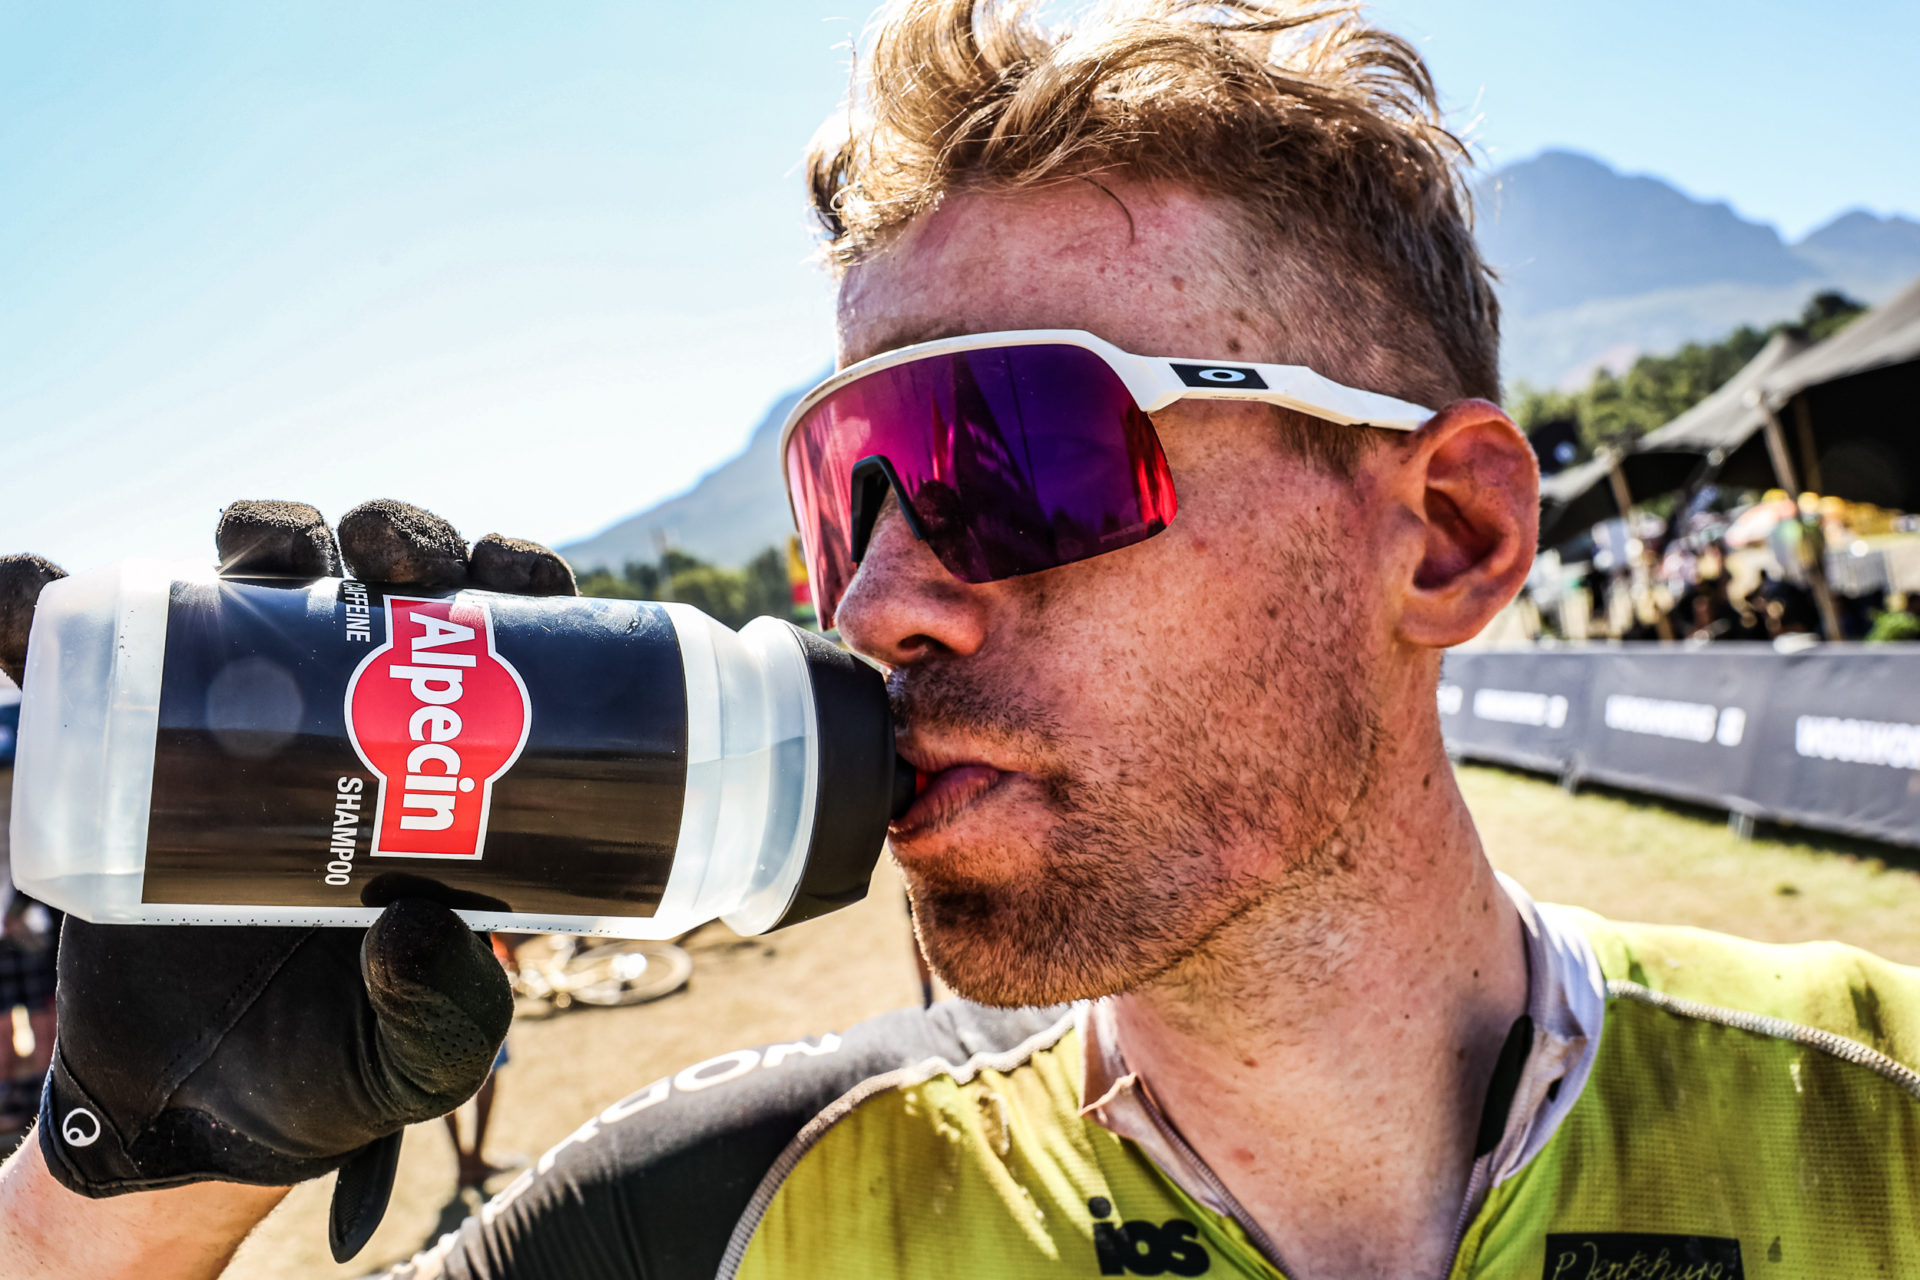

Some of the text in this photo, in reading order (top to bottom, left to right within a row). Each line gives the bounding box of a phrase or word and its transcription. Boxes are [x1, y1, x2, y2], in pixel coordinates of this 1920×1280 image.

[325, 582, 371, 886] CAFFEINE SHAMPOO
[389, 611, 477, 831] Alpecin
